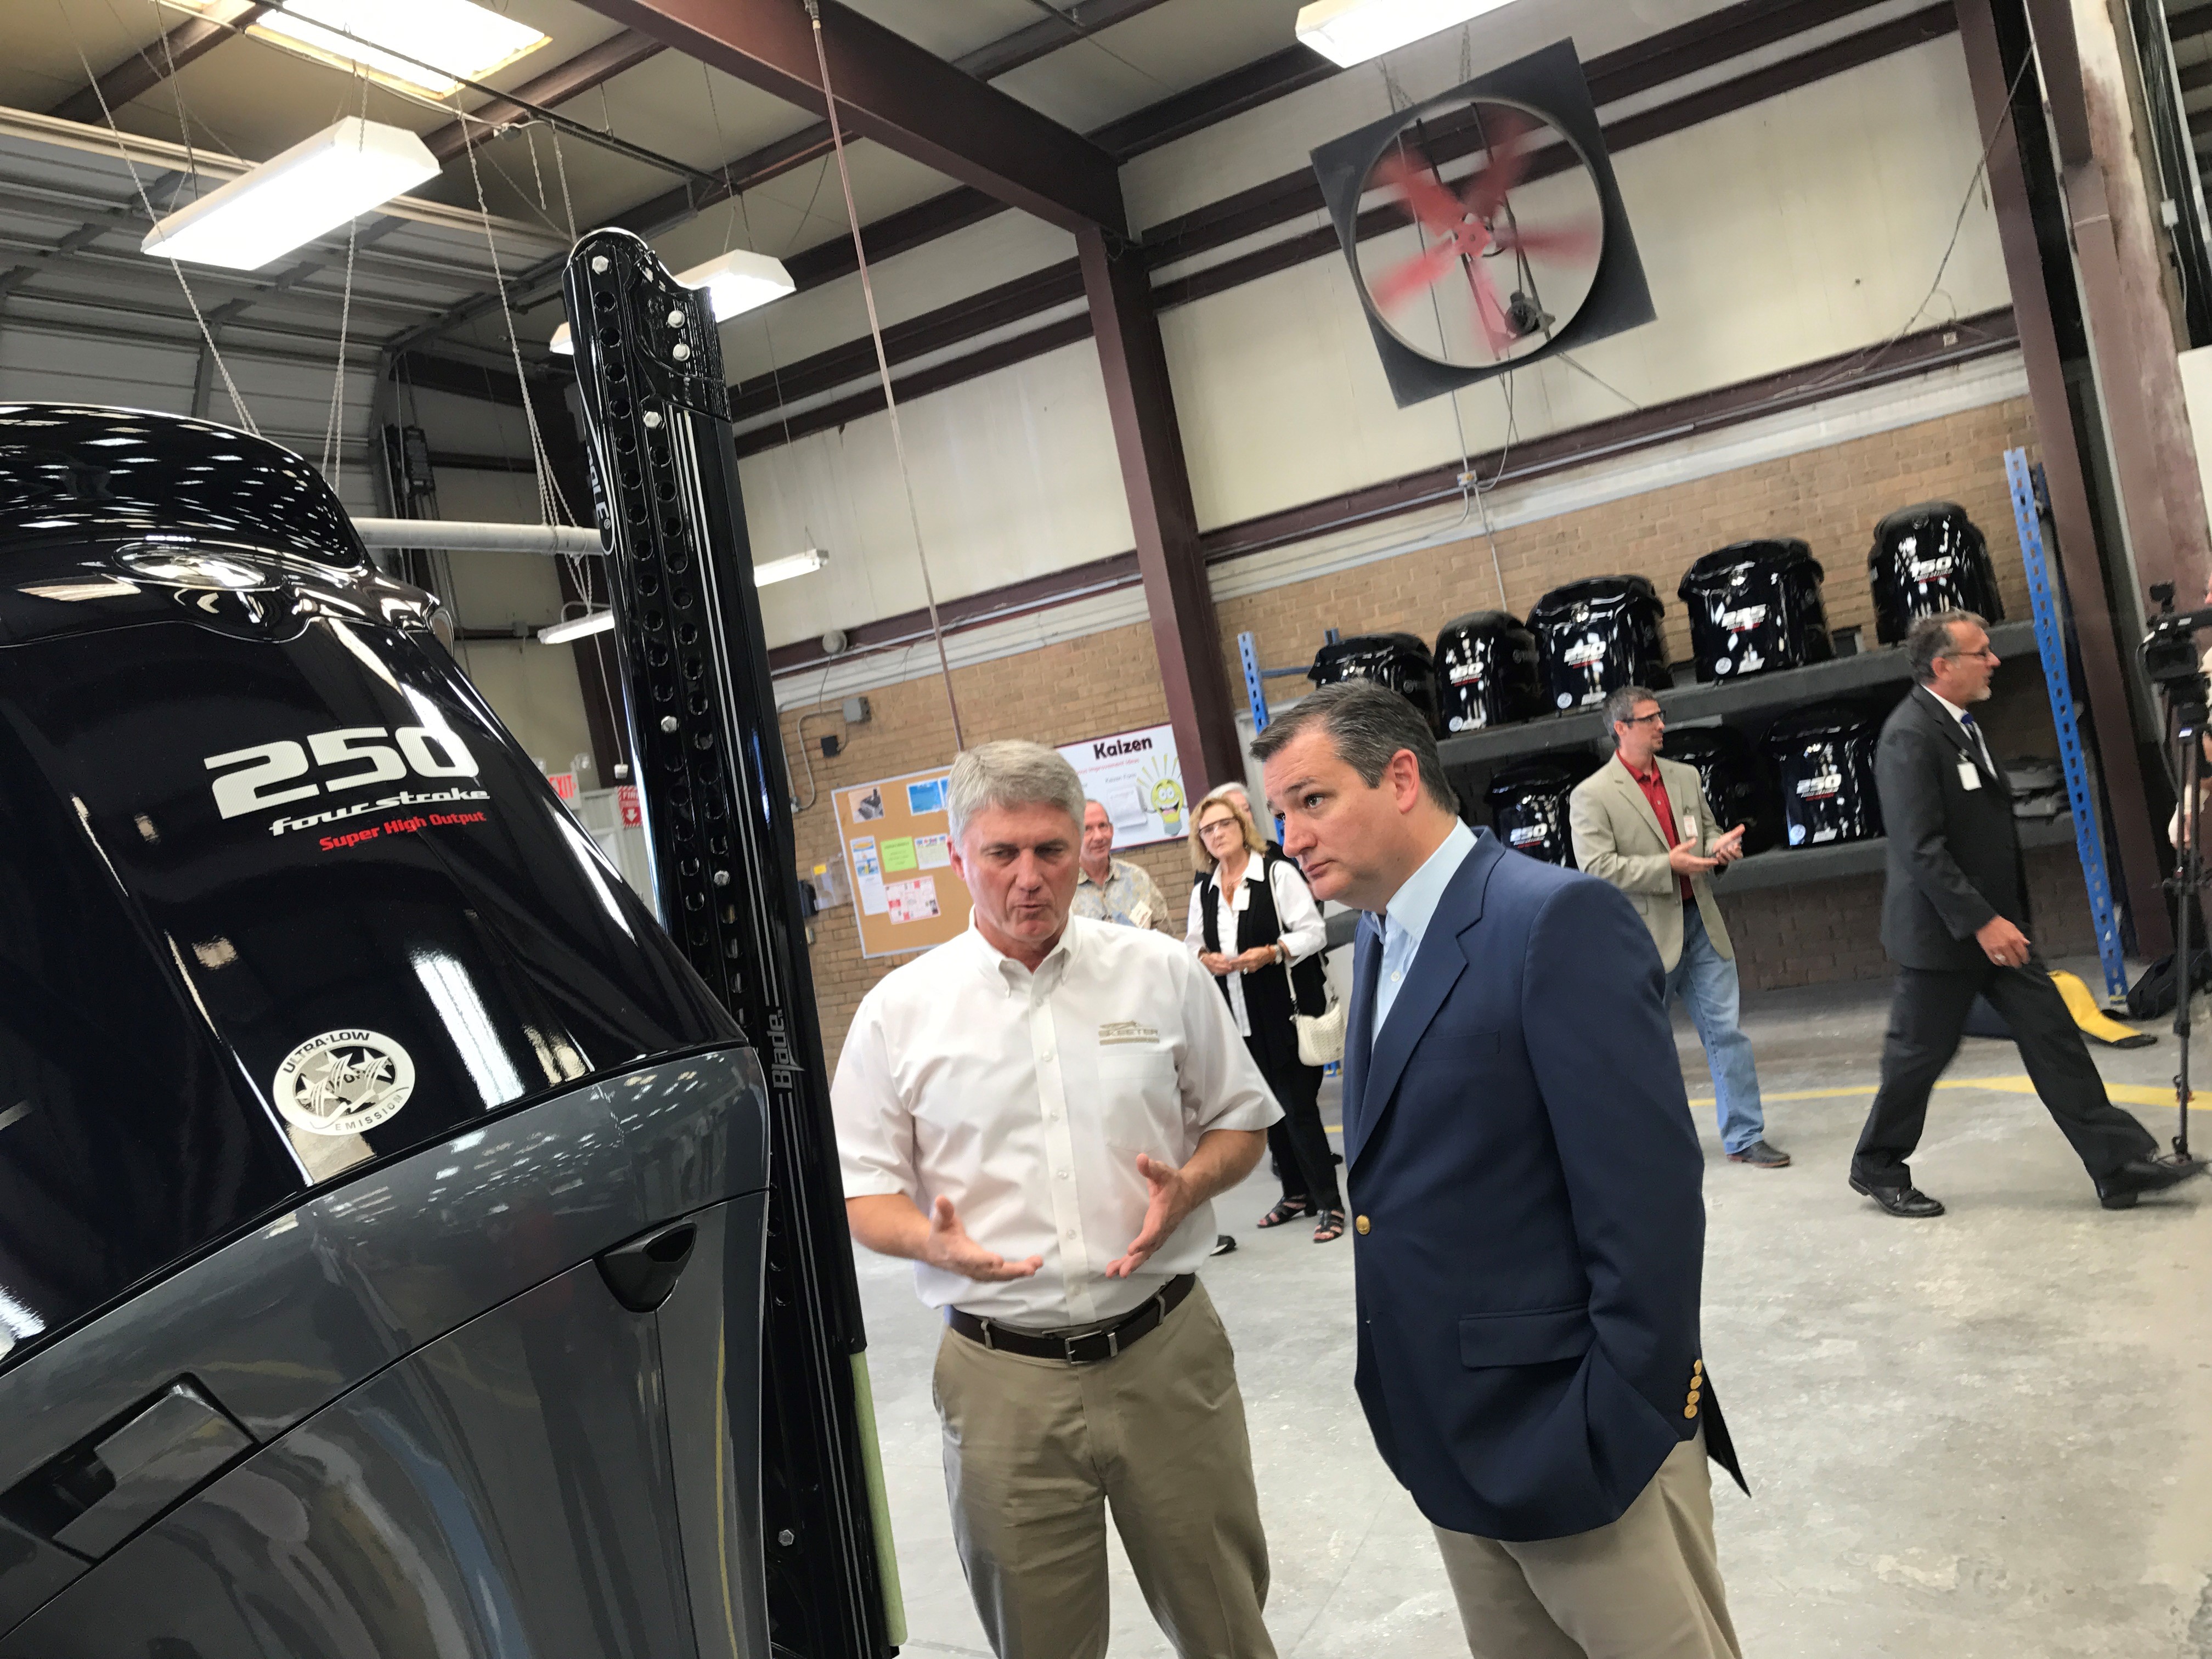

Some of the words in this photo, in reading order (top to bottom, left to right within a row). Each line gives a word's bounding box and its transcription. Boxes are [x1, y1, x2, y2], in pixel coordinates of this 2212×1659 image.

[1093, 737, 1153, 759] Kaizen
[204, 727, 479, 819] 250
[1796, 773, 1842, 794] 250
[319, 826, 380, 851] Super
[383, 815, 427, 834] High
[429, 811, 487, 826] Output
[1510, 823, 1547, 842] 250
[766, 1014, 805, 1088] Blade
[335, 1093, 403, 1131] EMISSION
